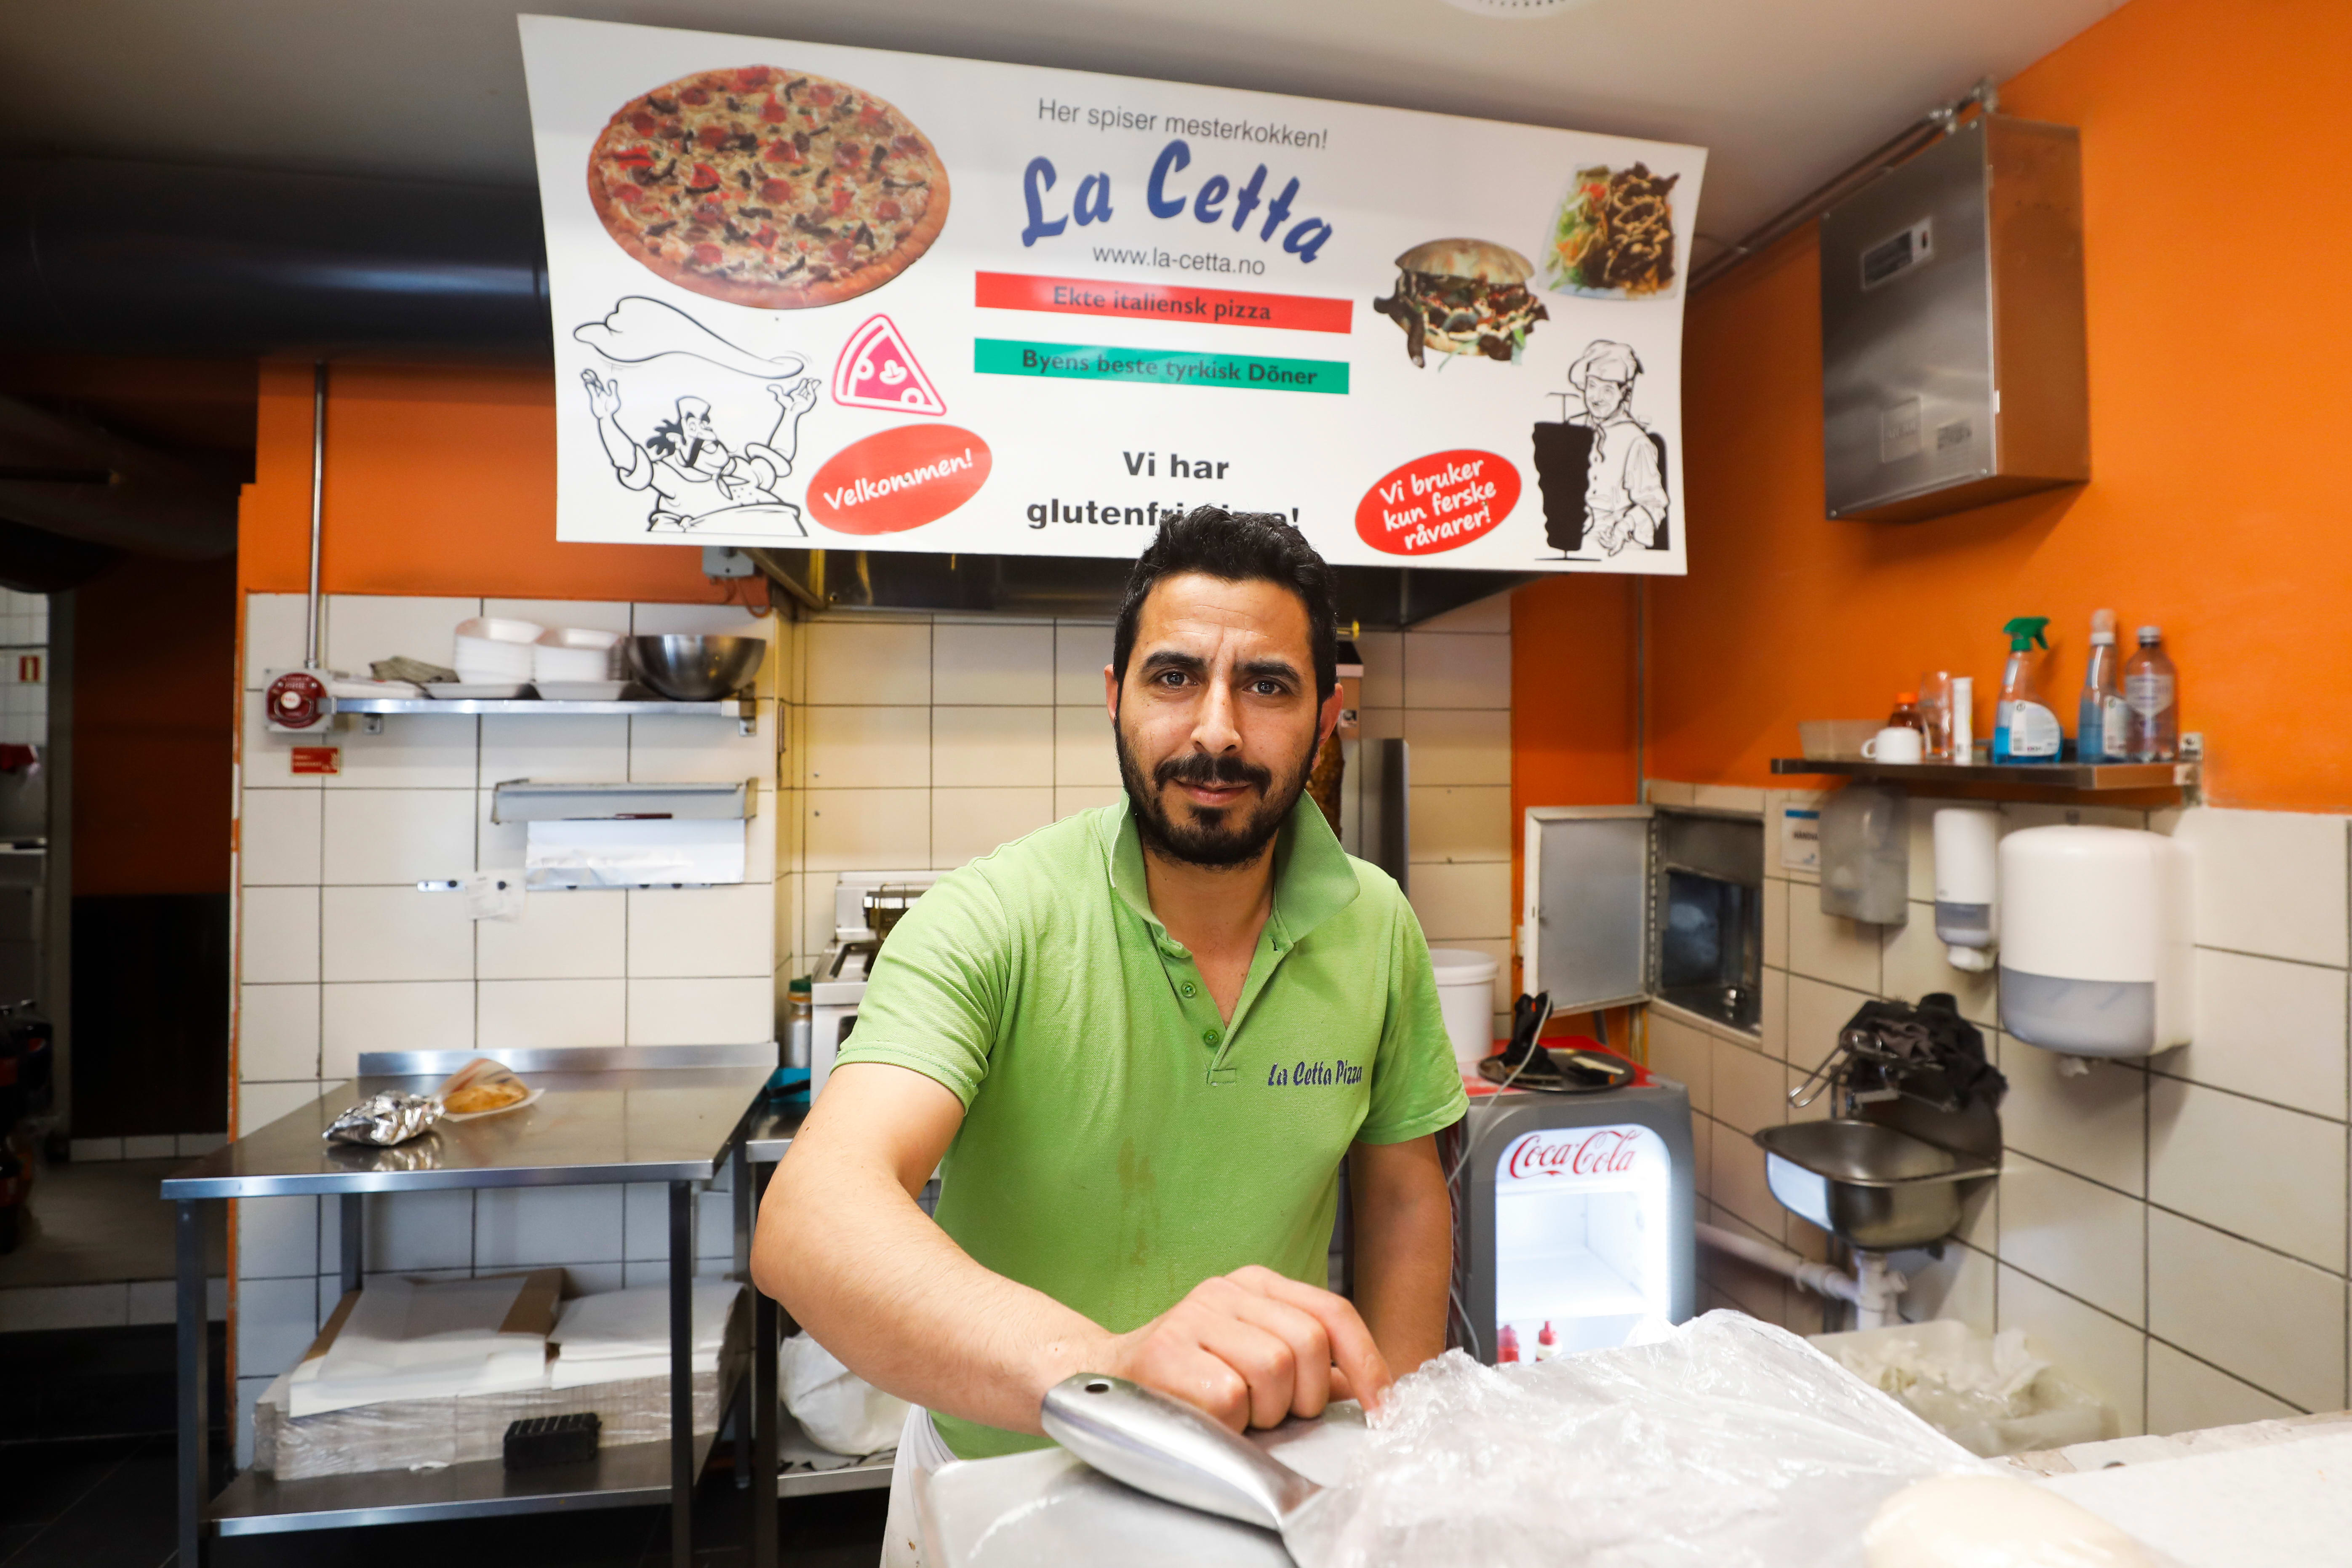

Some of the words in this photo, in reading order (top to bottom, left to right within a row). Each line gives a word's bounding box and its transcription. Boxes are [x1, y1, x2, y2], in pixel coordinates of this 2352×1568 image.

[1038, 98, 1080, 123] Her
[1087, 106, 1158, 132] spiser
[1164, 116, 1328, 149] mesterkokken!
[1022, 155, 1114, 247] La
[1147, 139, 1333, 263] Cetta
[1093, 246, 1266, 275] www.la-cetta.no
[1053, 286, 1105, 309] Ekte
[1114, 290, 1207, 316] italiensk
[1213, 302, 1271, 322] pizza
[1022, 349, 1090, 374] Byens
[1098, 355, 1157, 376] beste
[1166, 358, 1240, 381] tyrkisk
[824, 448, 972, 510] Velkommen!
[1123, 452, 1155, 476] Vi
[1170, 453, 1229, 479] har
[1379, 480, 1404, 504] Vi
[1411, 460, 1484, 495] bruker
[1383, 509, 1427, 531] kun
[1432, 481, 1496, 516] ferske
[1404, 502, 1491, 550] råvarer!
[1268, 1063, 1287, 1085] La
[1293, 1061, 1331, 1085] Cetta
[1336, 1060, 1362, 1085] Pizza
[1510, 1129, 1643, 1179] Coca-Cola
